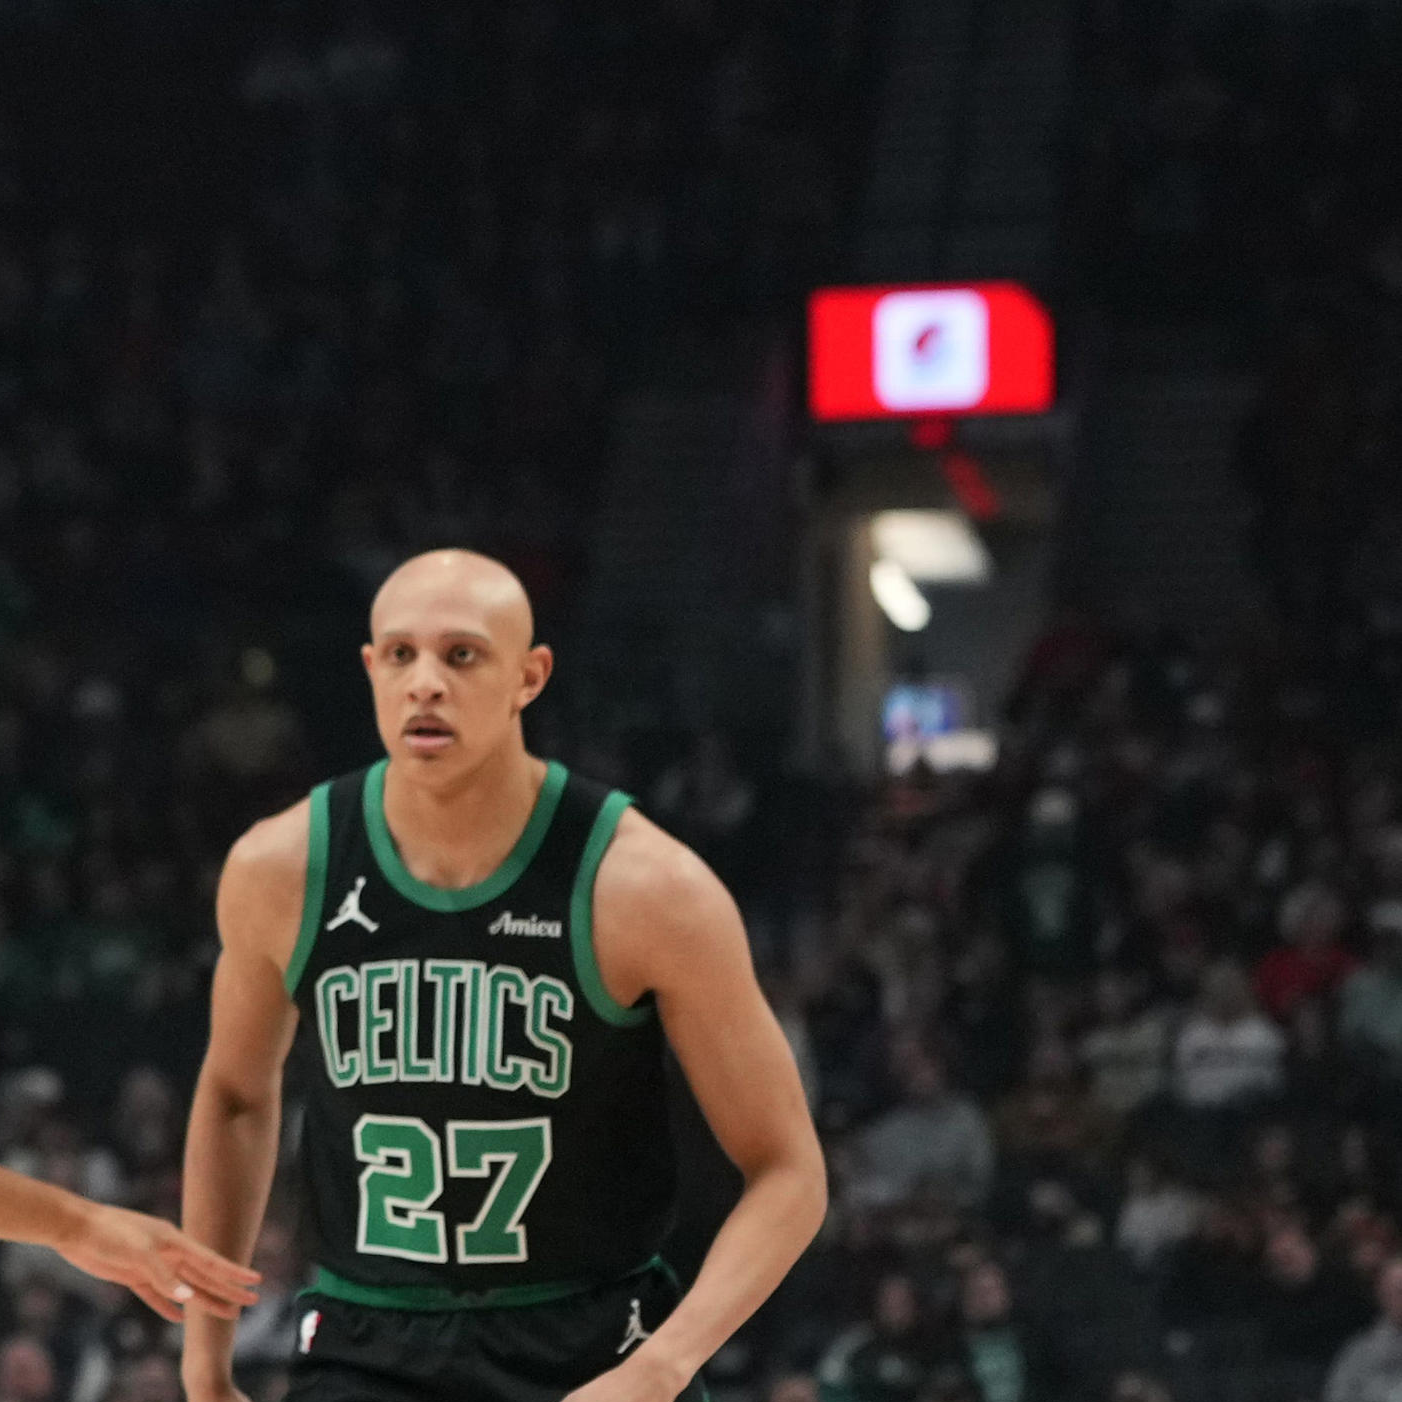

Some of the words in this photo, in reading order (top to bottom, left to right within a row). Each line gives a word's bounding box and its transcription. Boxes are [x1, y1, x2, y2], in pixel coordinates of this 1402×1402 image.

[489, 911, 563, 939] Amica
[315, 958, 574, 1099] CELTICS
[353, 1113, 553, 1264] 27
